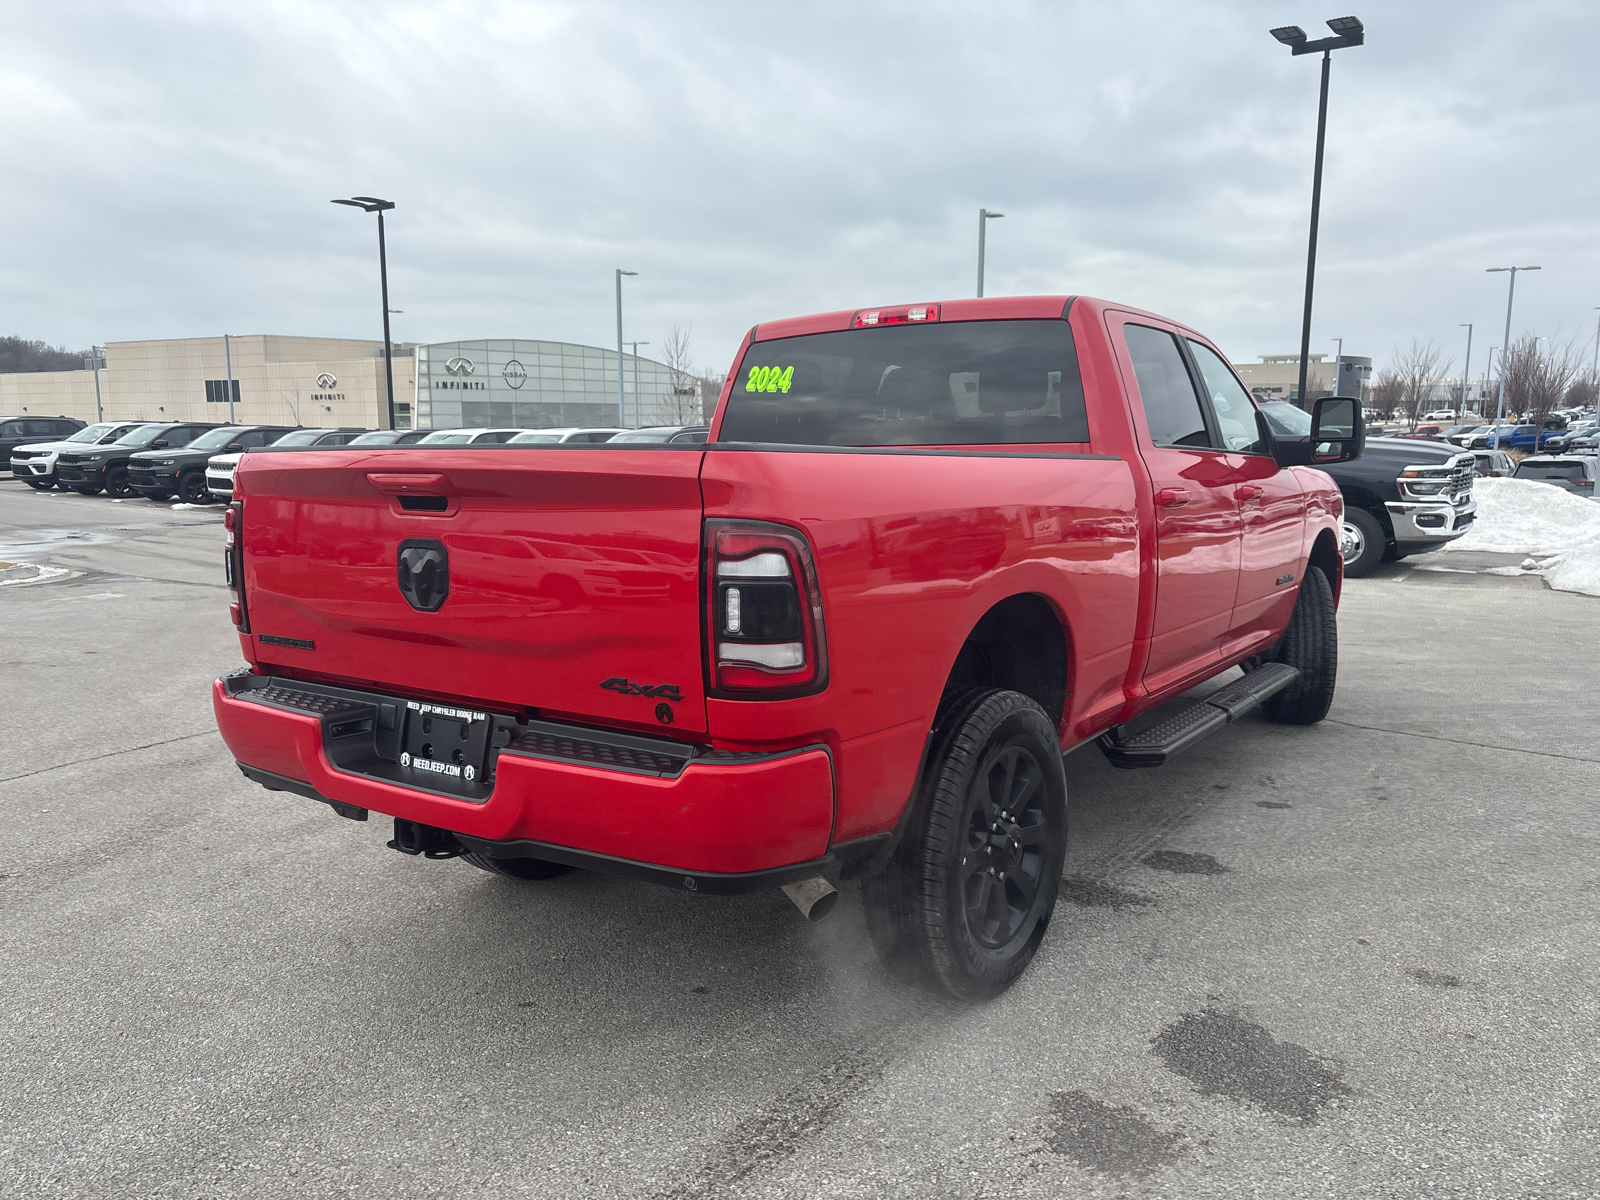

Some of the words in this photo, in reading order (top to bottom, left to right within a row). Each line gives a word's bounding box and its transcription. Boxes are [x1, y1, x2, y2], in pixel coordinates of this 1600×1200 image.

[435, 381, 485, 390] INFINITI
[745, 365, 795, 394] 2024
[407, 701, 420, 711] REED
[421, 704, 432, 713] JEEP
[432, 706, 456, 717] CHRYSLER
[456, 710, 473, 719] DODGE
[473, 712, 486, 721] RAM
[413, 758, 461, 777] REEDJEEP.COM
